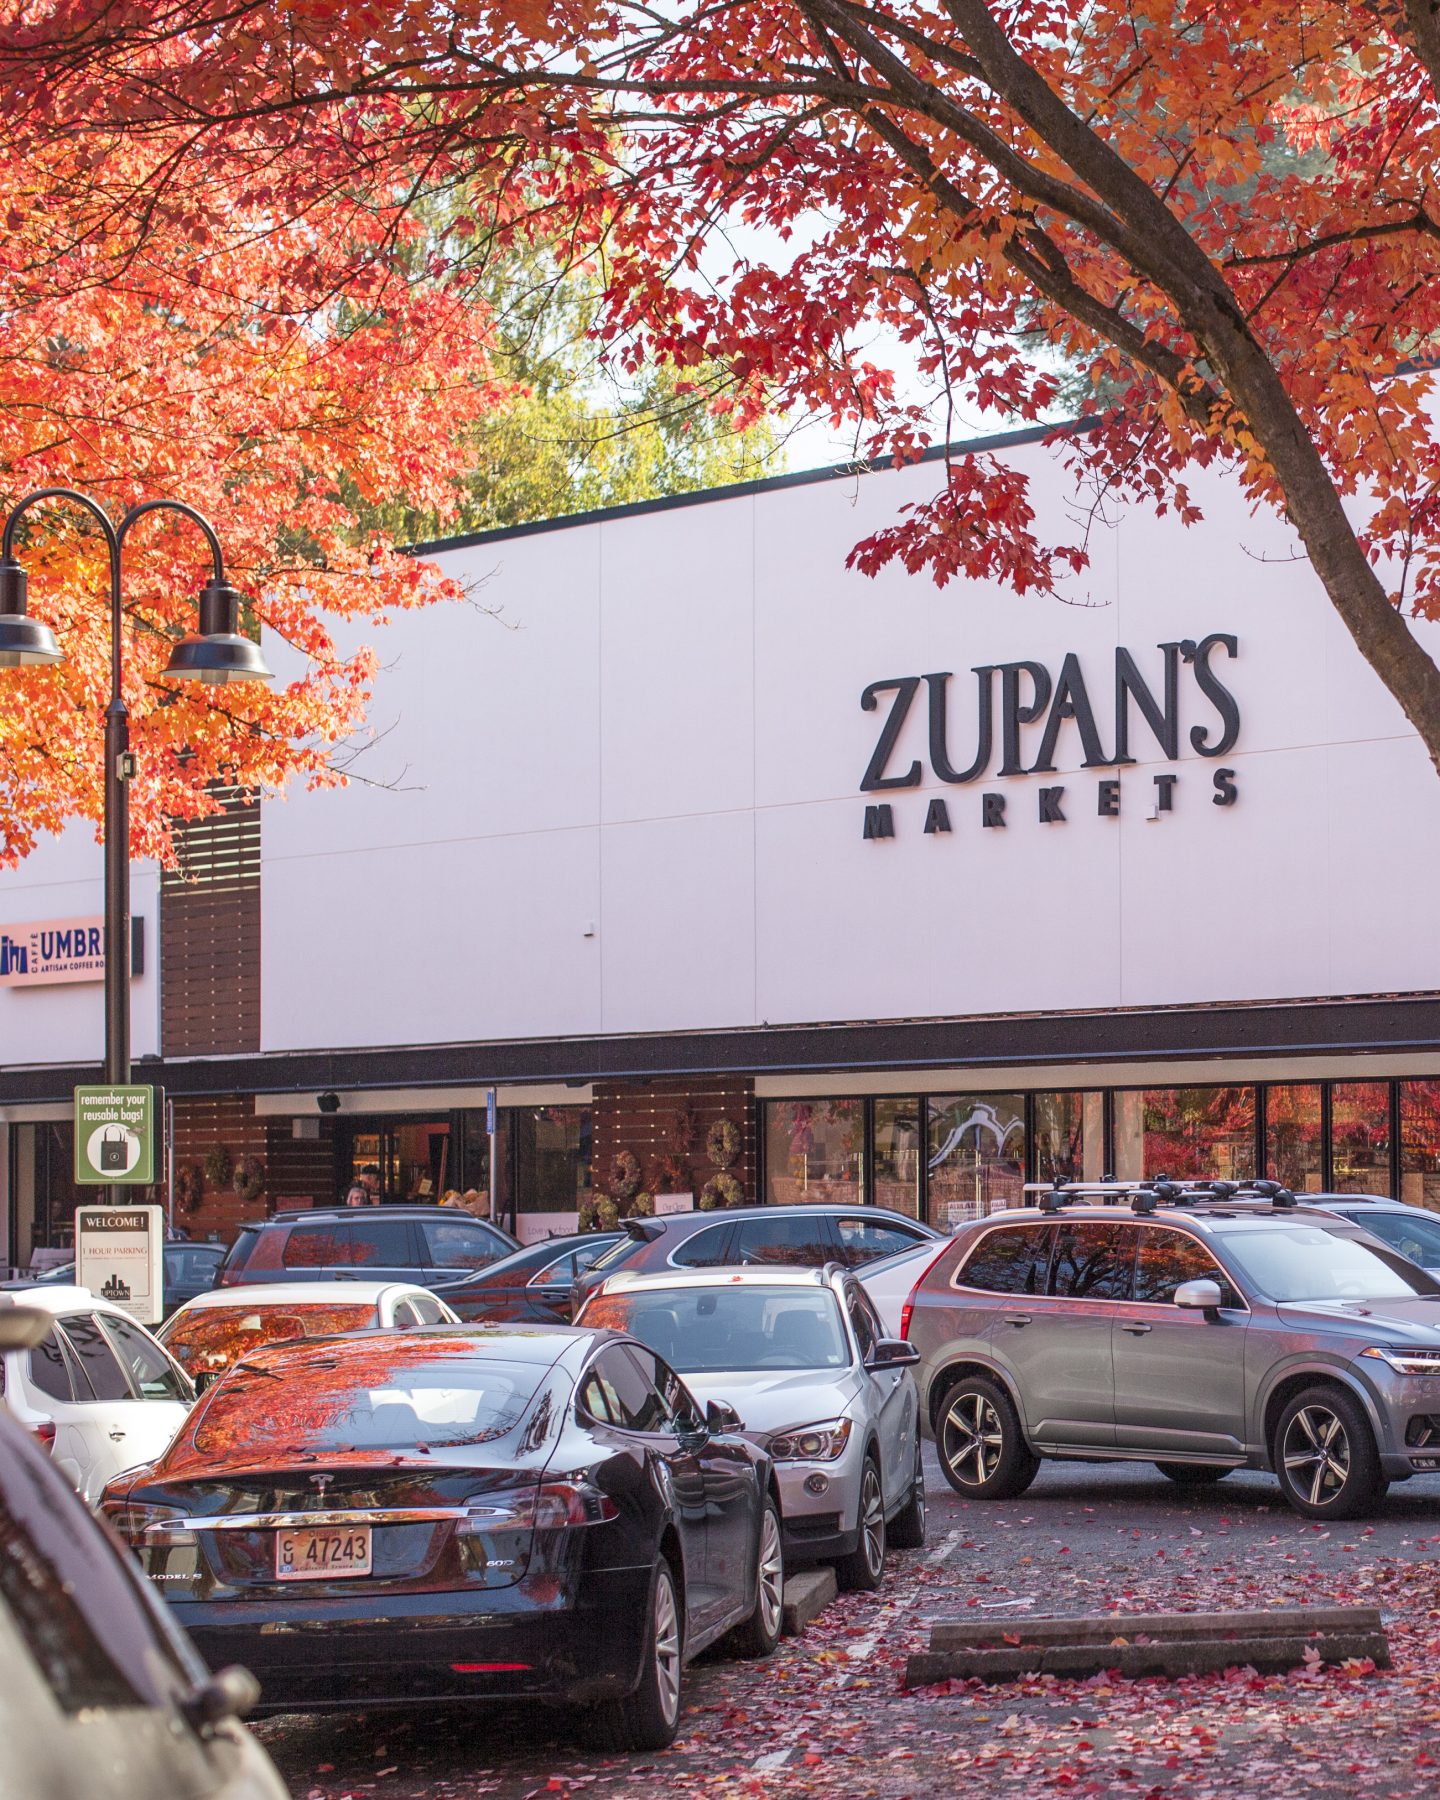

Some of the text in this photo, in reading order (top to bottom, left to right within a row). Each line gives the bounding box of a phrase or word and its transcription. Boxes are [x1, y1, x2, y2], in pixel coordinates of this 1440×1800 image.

[859, 633, 1240, 791] ZUPAN'S
[863, 768, 1238, 839] MARKETS
[41, 927, 105, 960] UMBR
[41, 962, 68, 973] ARTISAN
[70, 961, 93, 971] COFFEE
[81, 1092, 146, 1107] remember your
[83, 1107, 143, 1123] reusable bags!
[86, 1217, 144, 1228] WELCOME!
[83, 1247, 147, 1255] 1 HOUR PARKING
[101, 1289, 130, 1297] UPTOWN
[306, 1536, 366, 1563] 47243
